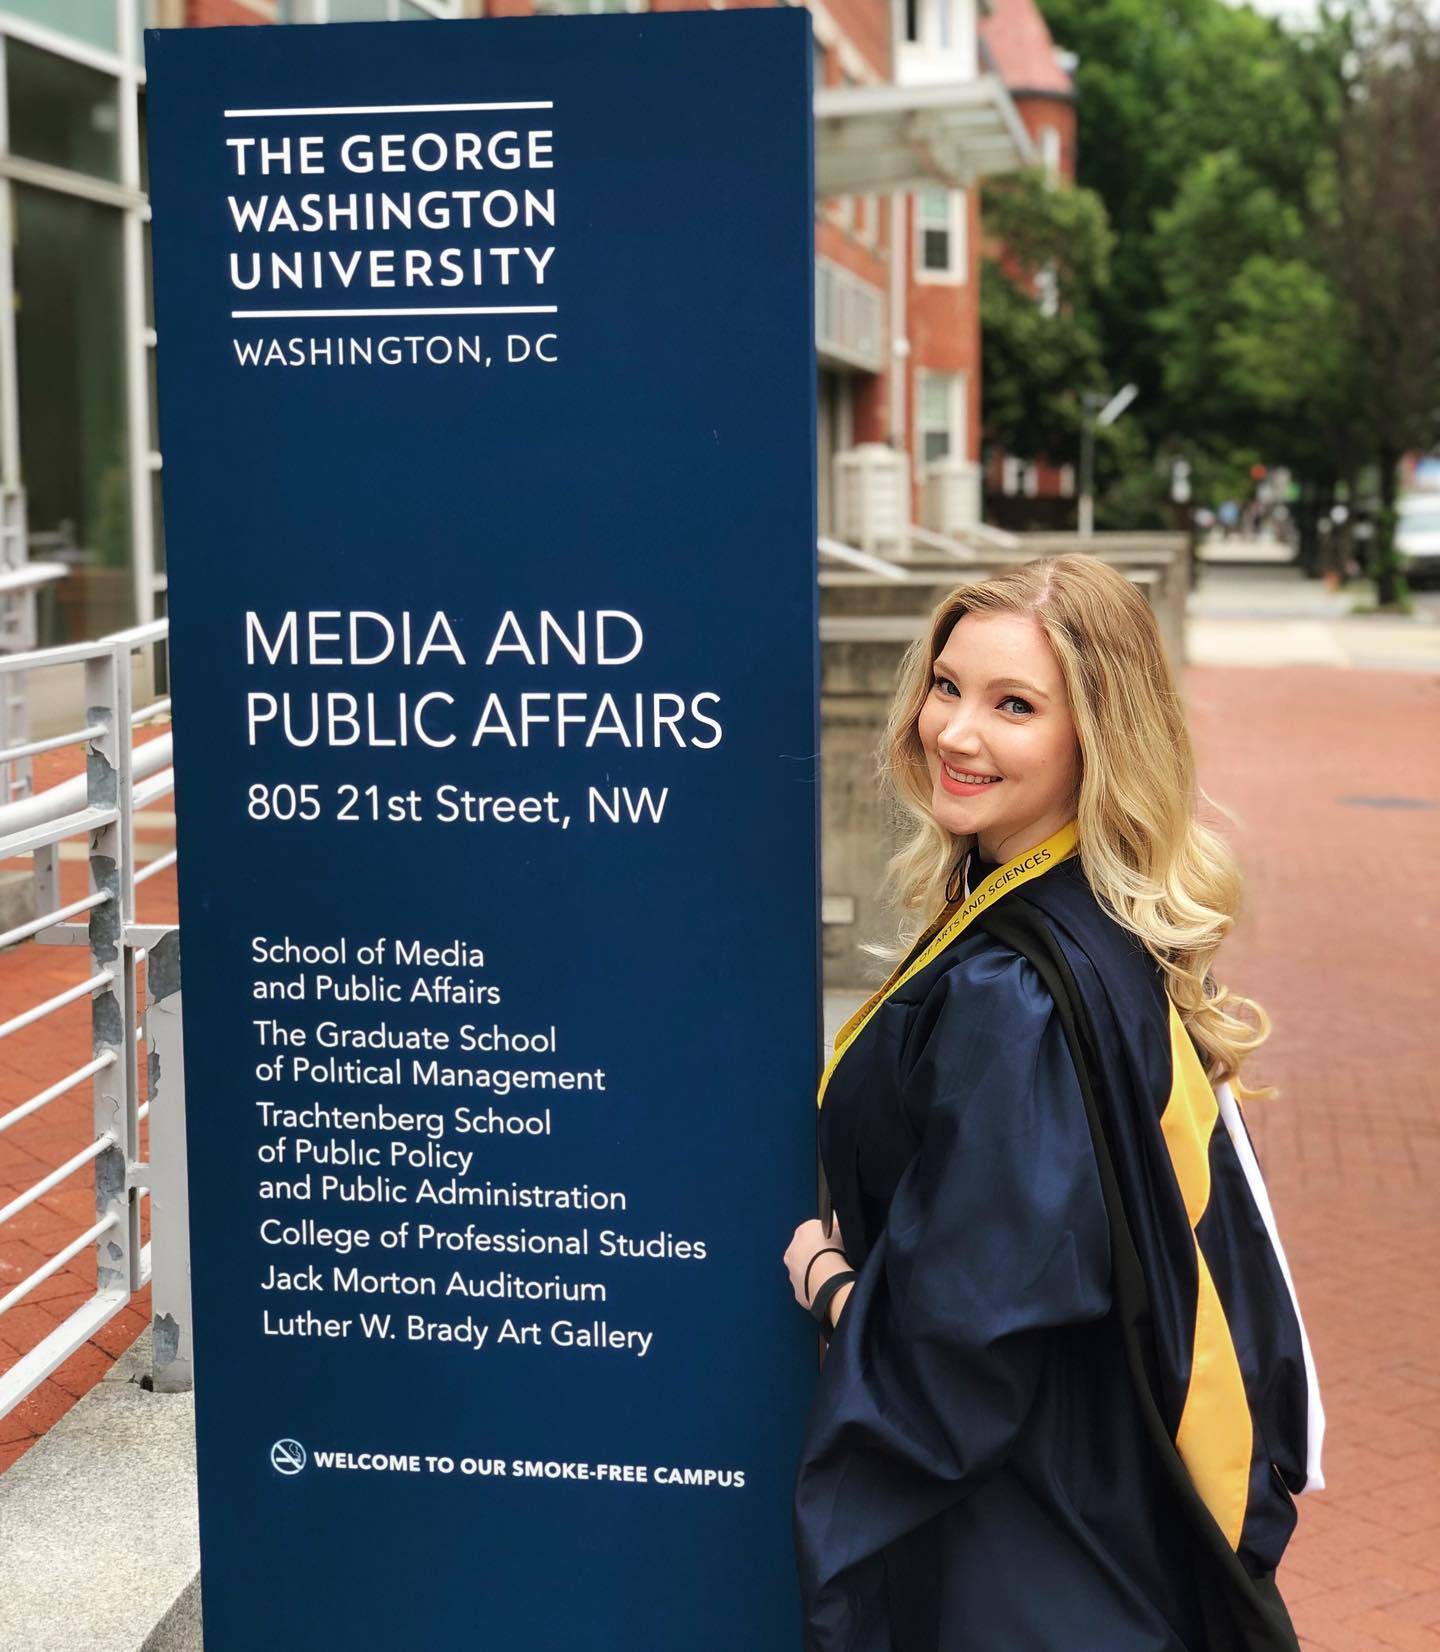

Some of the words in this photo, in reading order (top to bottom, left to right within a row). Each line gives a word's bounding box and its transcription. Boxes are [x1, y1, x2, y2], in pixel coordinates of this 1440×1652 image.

[226, 137, 324, 175] THE
[341, 131, 553, 173] GEORGE
[228, 189, 554, 232] WASHINGTON
[230, 247, 555, 290] UNIVERSITY
[234, 336, 491, 367] WASHINGTON,
[508, 334, 557, 362] DC
[246, 611, 466, 665] MEDIA
[486, 610, 643, 665] AND
[248, 692, 456, 747] PUBLIC
[472, 692, 722, 748] AFFAIRS
[248, 784, 320, 820] 805
[337, 785, 422, 821] 21st
[437, 785, 570, 829] Street,
[589, 787, 668, 823] NW
[935, 918, 960, 946] ARTS
[961, 893, 986, 920] AND
[988, 848, 1051, 895] SCIENCES
[252, 937, 345, 964] School
[357, 938, 386, 964] of
[396, 940, 483, 967] Media
[254, 974, 304, 999] and
[317, 975, 401, 1002] Public
[410, 976, 500, 1004] Affairs
[253, 1020, 306, 1046] The
[316, 1022, 449, 1049] Graduate
[460, 1025, 555, 1052] School
[256, 1055, 284, 1081] of
[294, 1057, 400, 1084] Political
[413, 1061, 605, 1095] Management
[256, 1102, 443, 1139] Trachtenberg
[455, 1107, 550, 1134] School
[258, 1137, 286, 1162] of
[296, 1139, 380, 1165] Public
[391, 1142, 473, 1176] Policy
[260, 1174, 310, 1199] and
[323, 1176, 407, 1203] Public
[416, 1178, 625, 1210] Administration
[260, 1219, 370, 1253] College
[381, 1222, 409, 1248] of
[419, 1224, 587, 1254] Professional
[600, 1230, 706, 1259] Studies
[261, 1265, 323, 1291] Jack
[334, 1267, 435, 1294] Morton
[446, 1272, 605, 1301] Auditorium
[264, 1310, 352, 1337] Luther
[360, 1314, 395, 1339] W.
[408, 1315, 488, 1349] Brady
[497, 1319, 541, 1345] Art
[551, 1321, 652, 1356] Gallery
[314, 1452, 420, 1472] WELCOME
[425, 1457, 454, 1473] TO
[460, 1458, 506, 1475] OUR
[513, 1460, 647, 1482] SMOKE-FREE
[654, 1467, 744, 1487] CAMPUS
